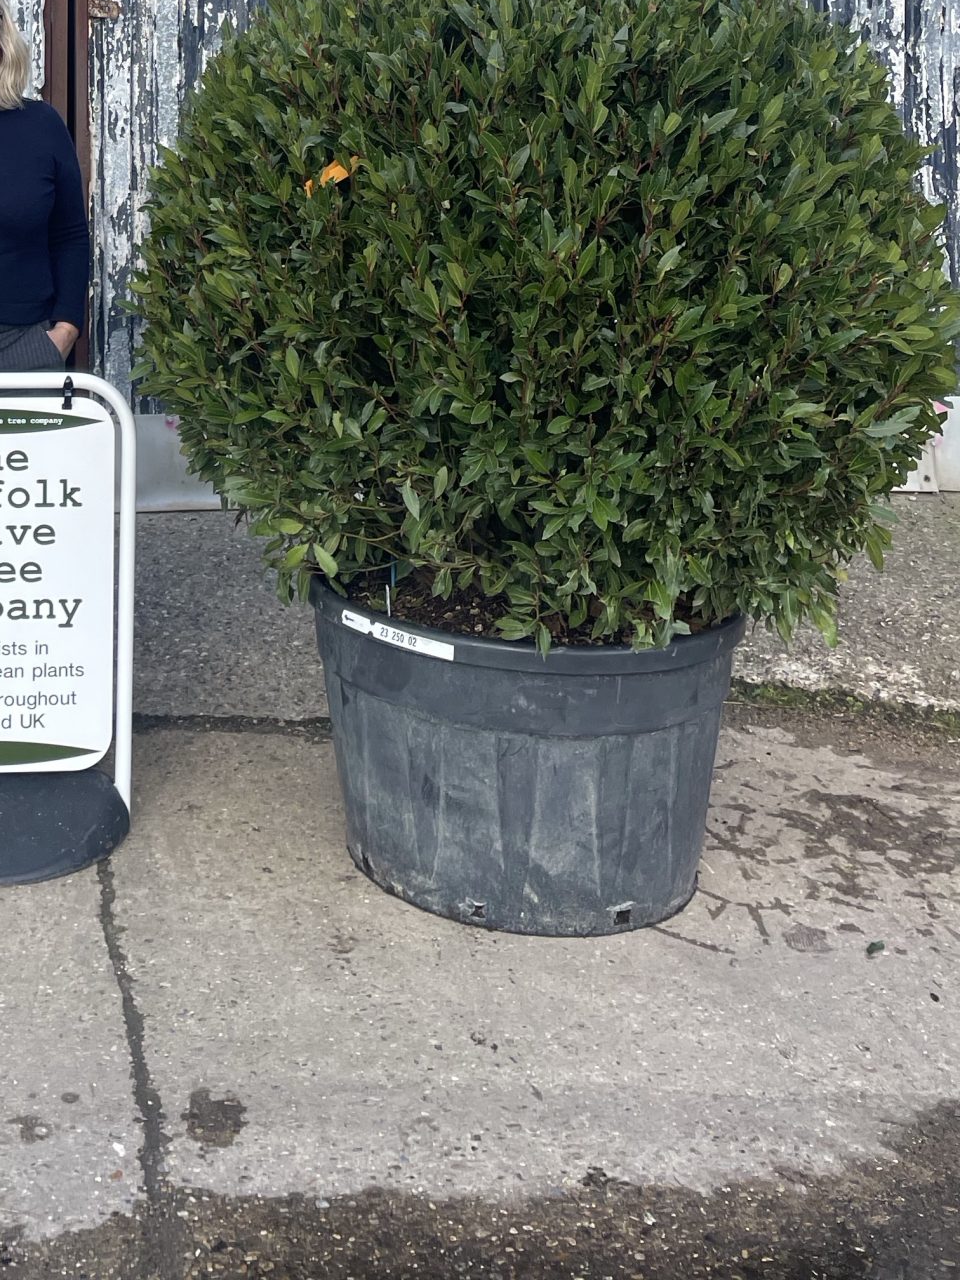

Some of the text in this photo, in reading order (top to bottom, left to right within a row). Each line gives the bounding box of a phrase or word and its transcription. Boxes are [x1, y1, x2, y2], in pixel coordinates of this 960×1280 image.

[30, 417, 63, 425] company
[380, 627, 389, 638] 23
[391, 631, 405, 643] 250
[35, 640, 49, 655] in
[32, 662, 85, 682] plants
[20, 714, 46, 729] UK
